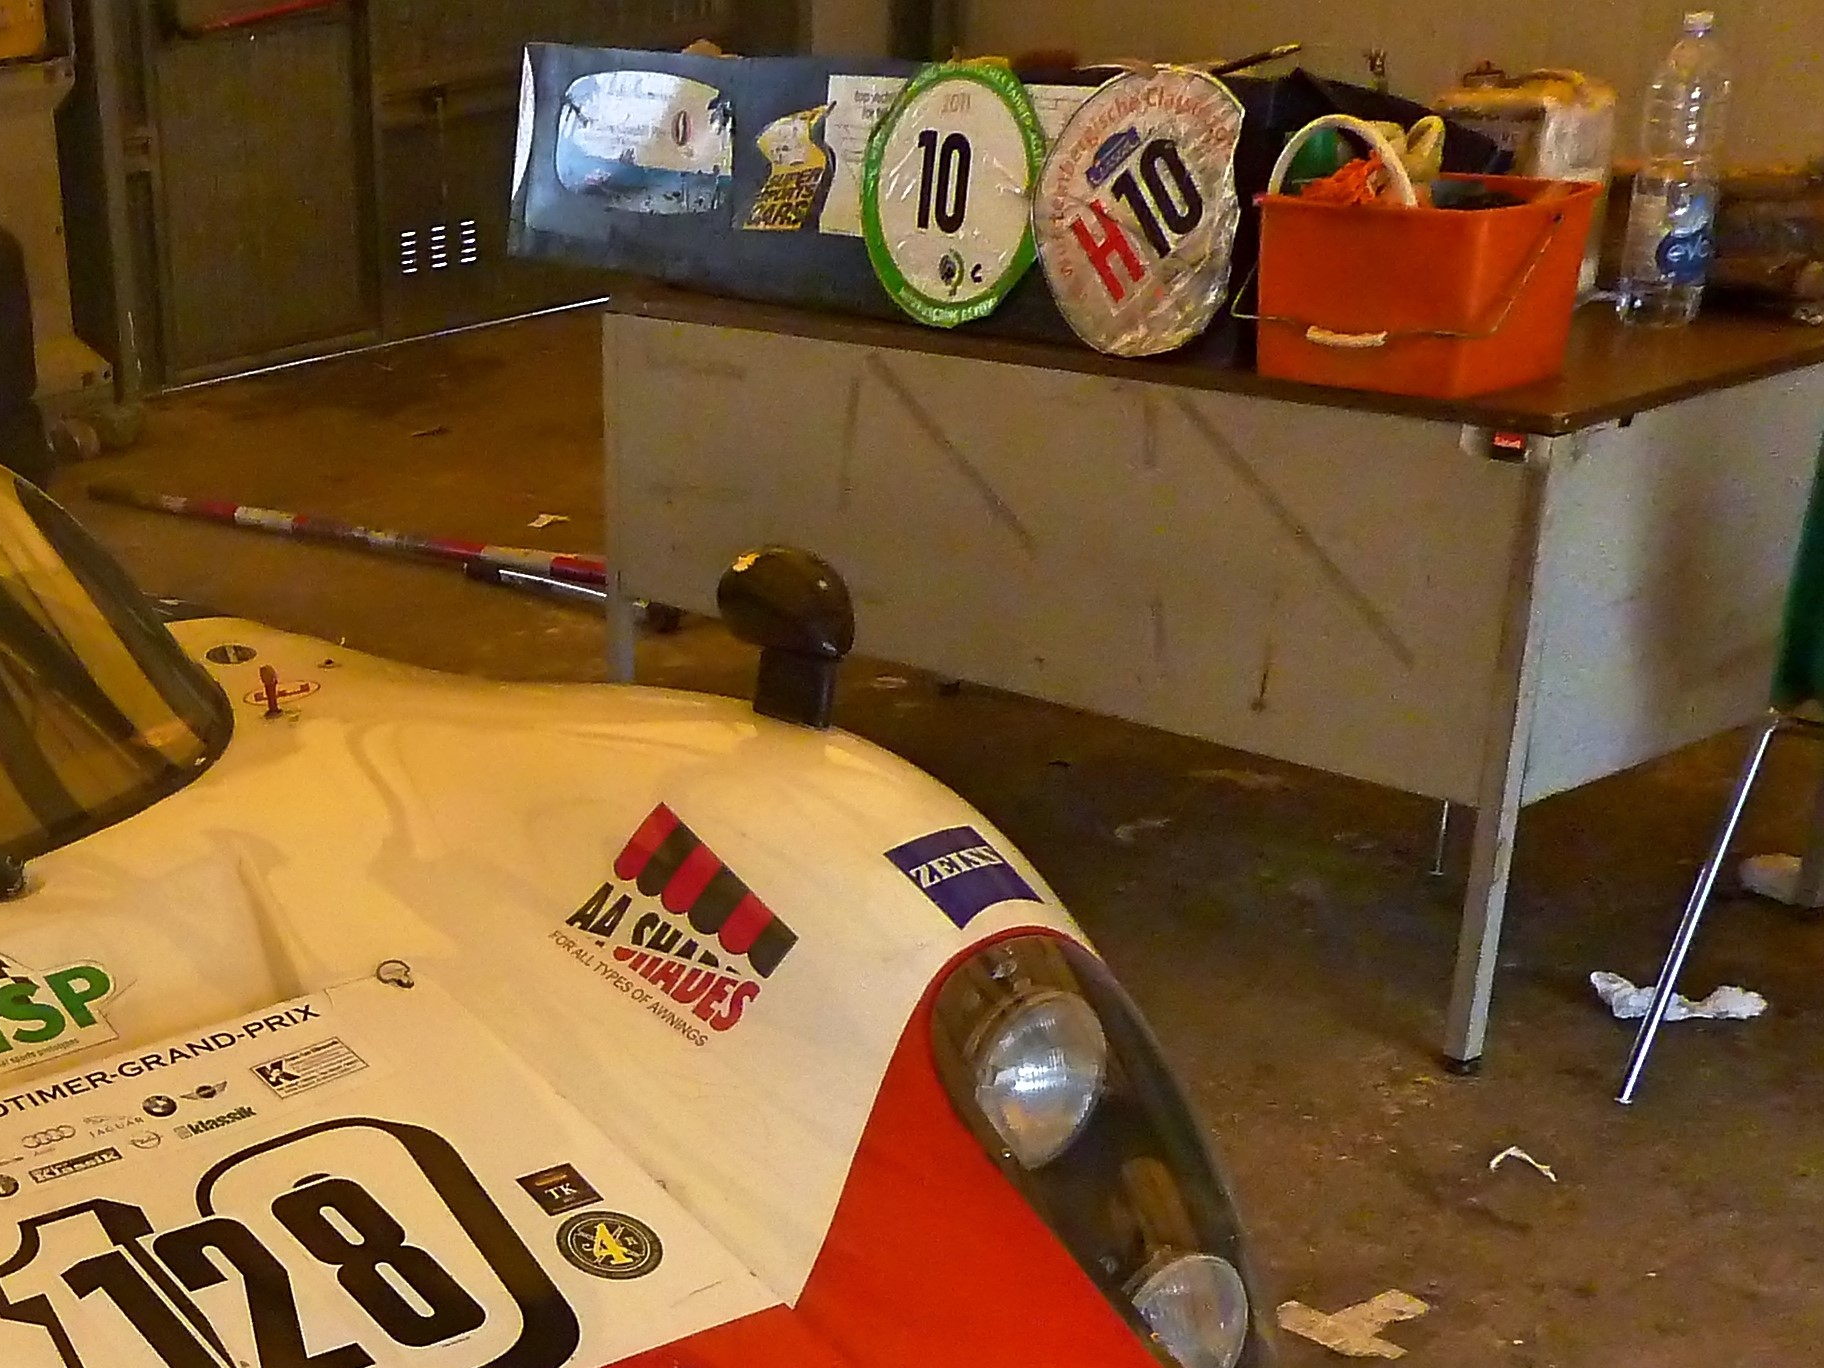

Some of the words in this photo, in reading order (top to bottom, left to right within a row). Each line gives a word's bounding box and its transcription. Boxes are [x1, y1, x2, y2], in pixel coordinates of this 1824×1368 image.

[918, 129, 972, 234] 10
[908, 846, 1004, 888] ZEISS
[548, 929, 577, 951] FOR
[569, 944, 592, 968] ALL
[594, 960, 634, 994] TYPES
[631, 987, 654, 1005] OF
[646, 1001, 710, 1048] AWNINGS
[87, 1115, 145, 1139] JAGUAR
[543, 1181, 580, 1200] TK
